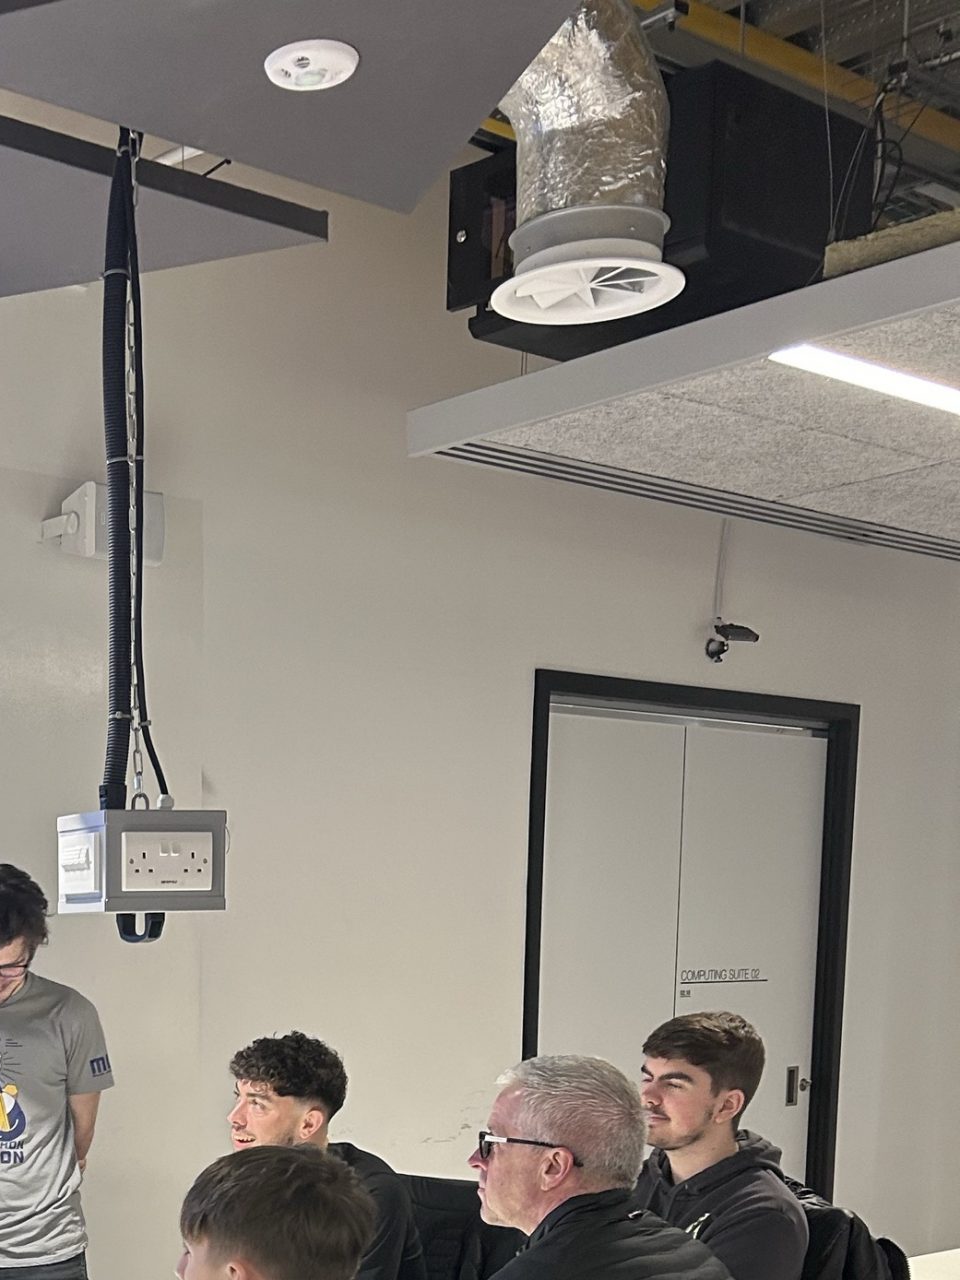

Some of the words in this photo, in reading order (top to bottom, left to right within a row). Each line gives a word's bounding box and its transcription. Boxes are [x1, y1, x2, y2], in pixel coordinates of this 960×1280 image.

[680, 969, 727, 981] COMPUTING
[729, 968, 749, 980] SUITE
[751, 968, 760, 979] 02
